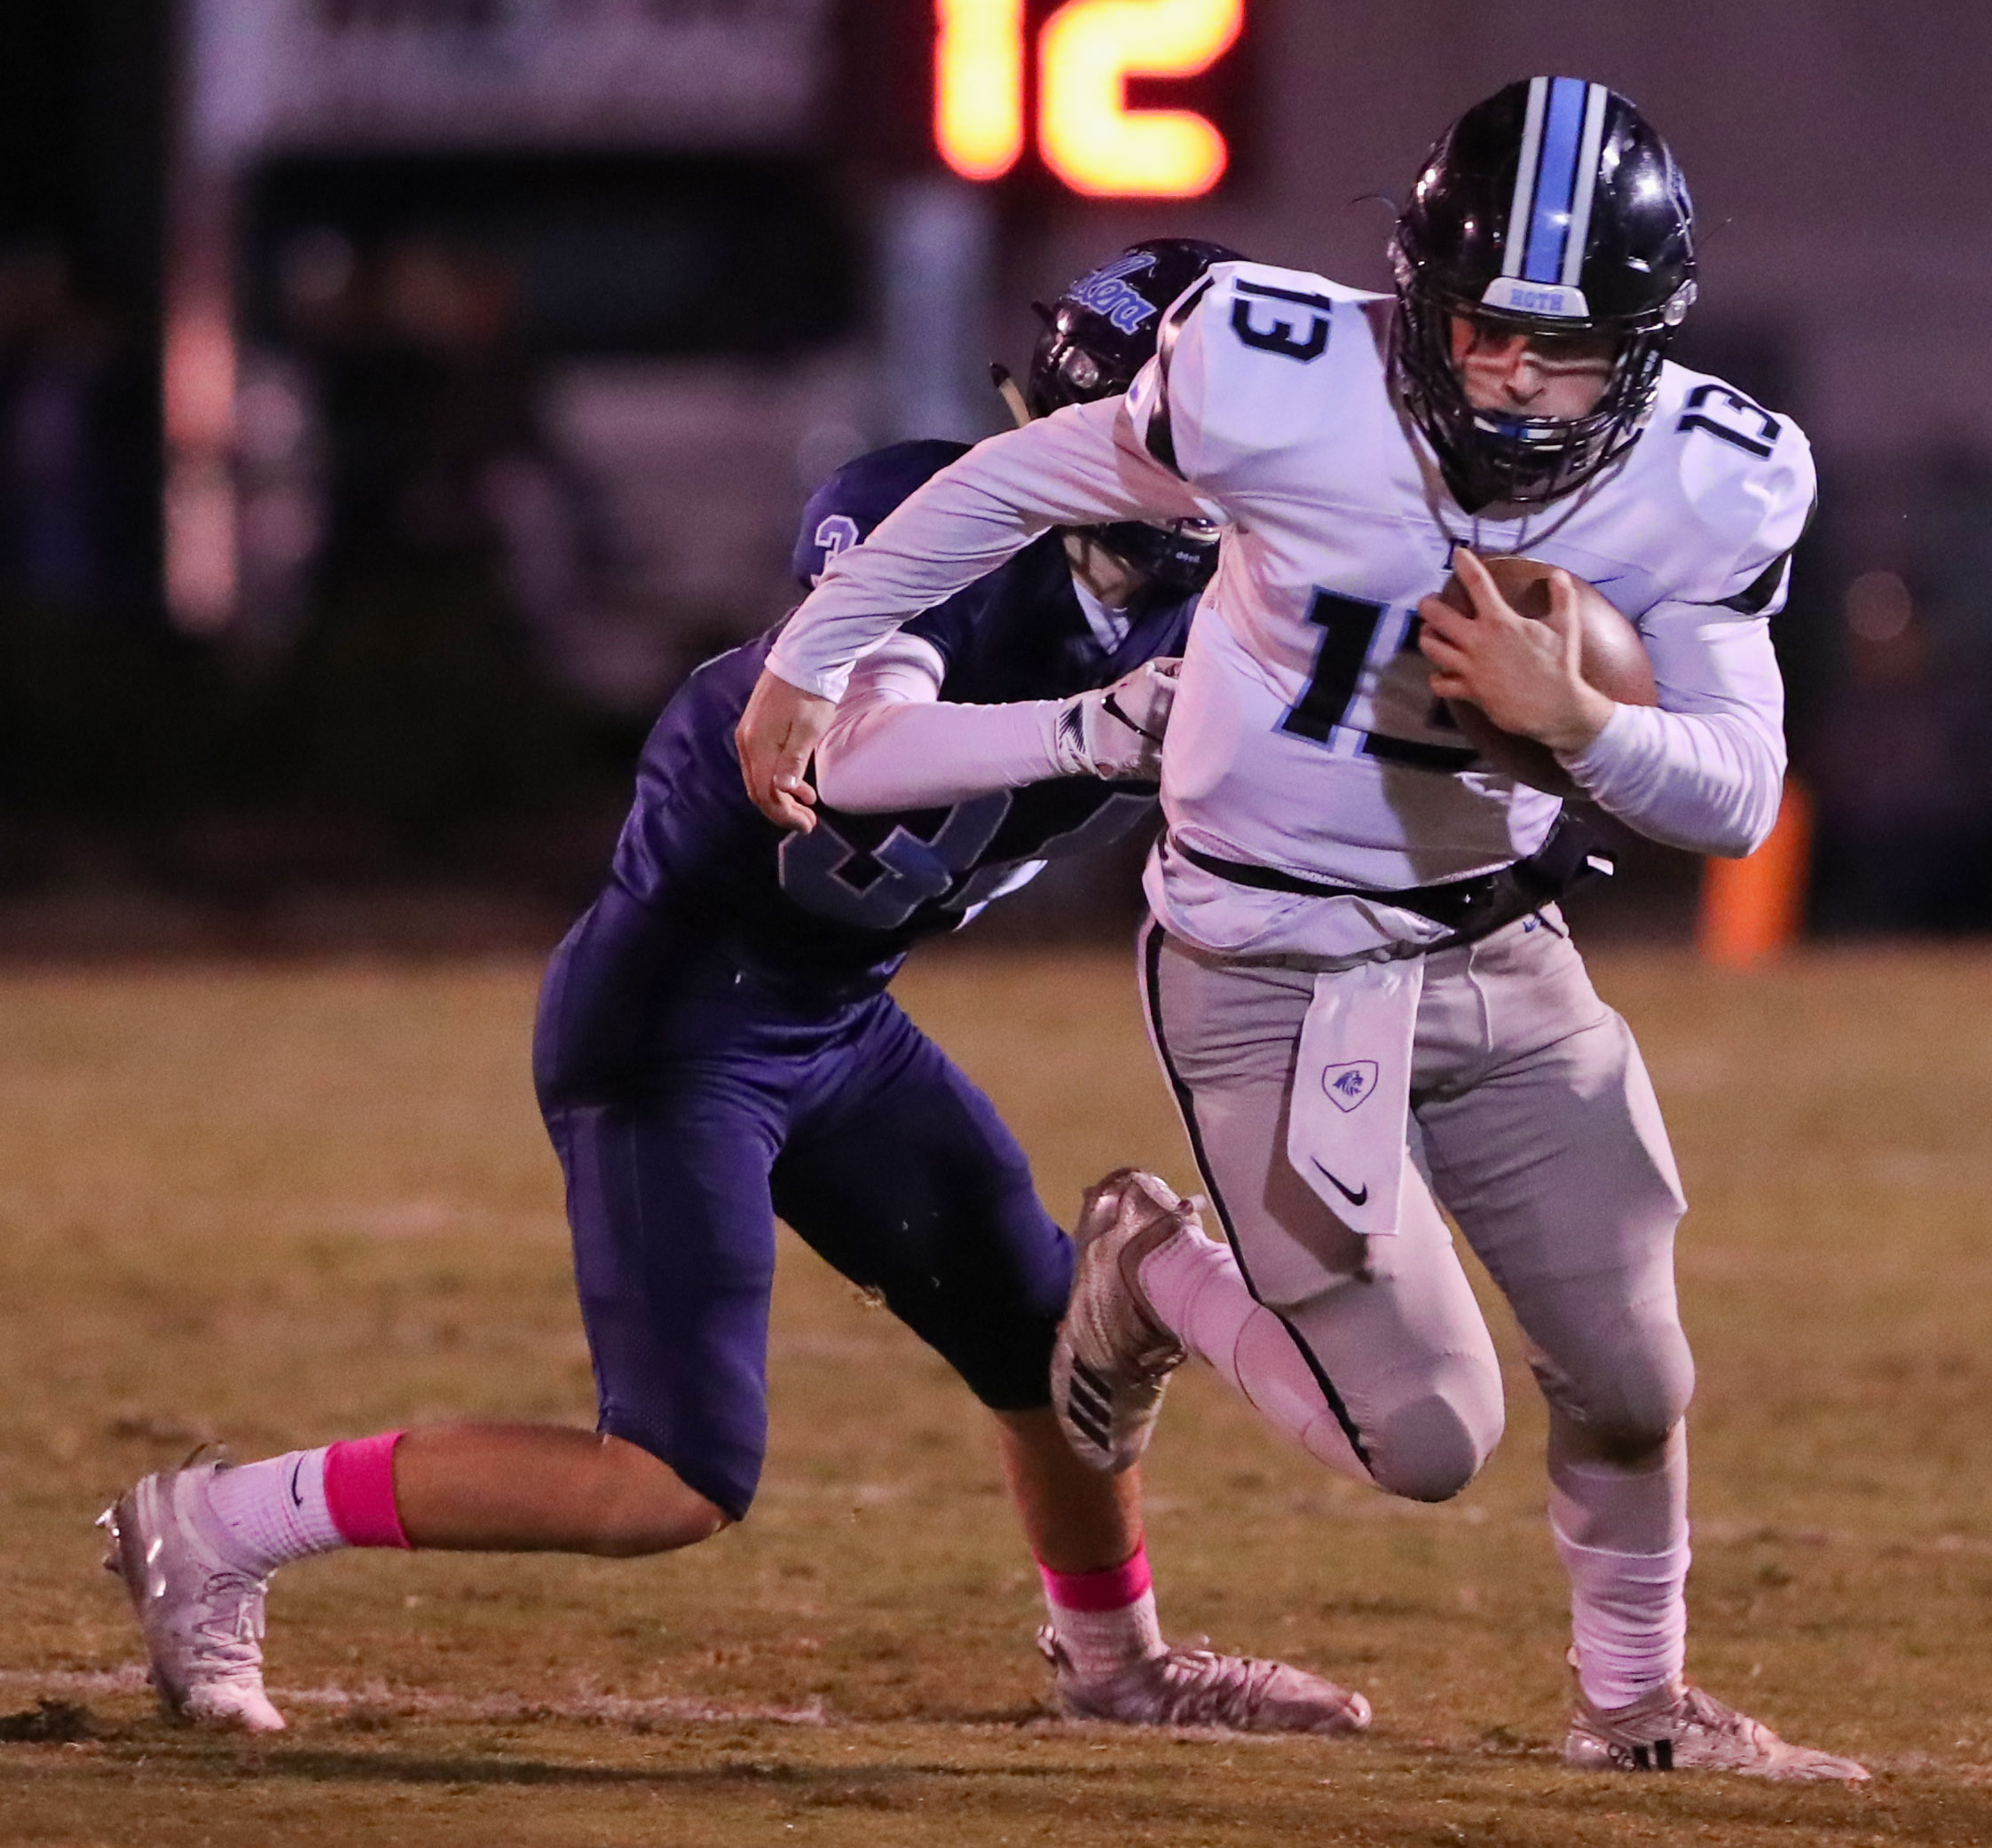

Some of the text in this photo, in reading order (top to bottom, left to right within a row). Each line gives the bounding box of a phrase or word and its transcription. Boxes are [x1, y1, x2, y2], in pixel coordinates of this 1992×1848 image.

[933, 0, 1245, 199] 12
[1230, 274, 1333, 365] 13
[1674, 383, 1782, 461] 13
